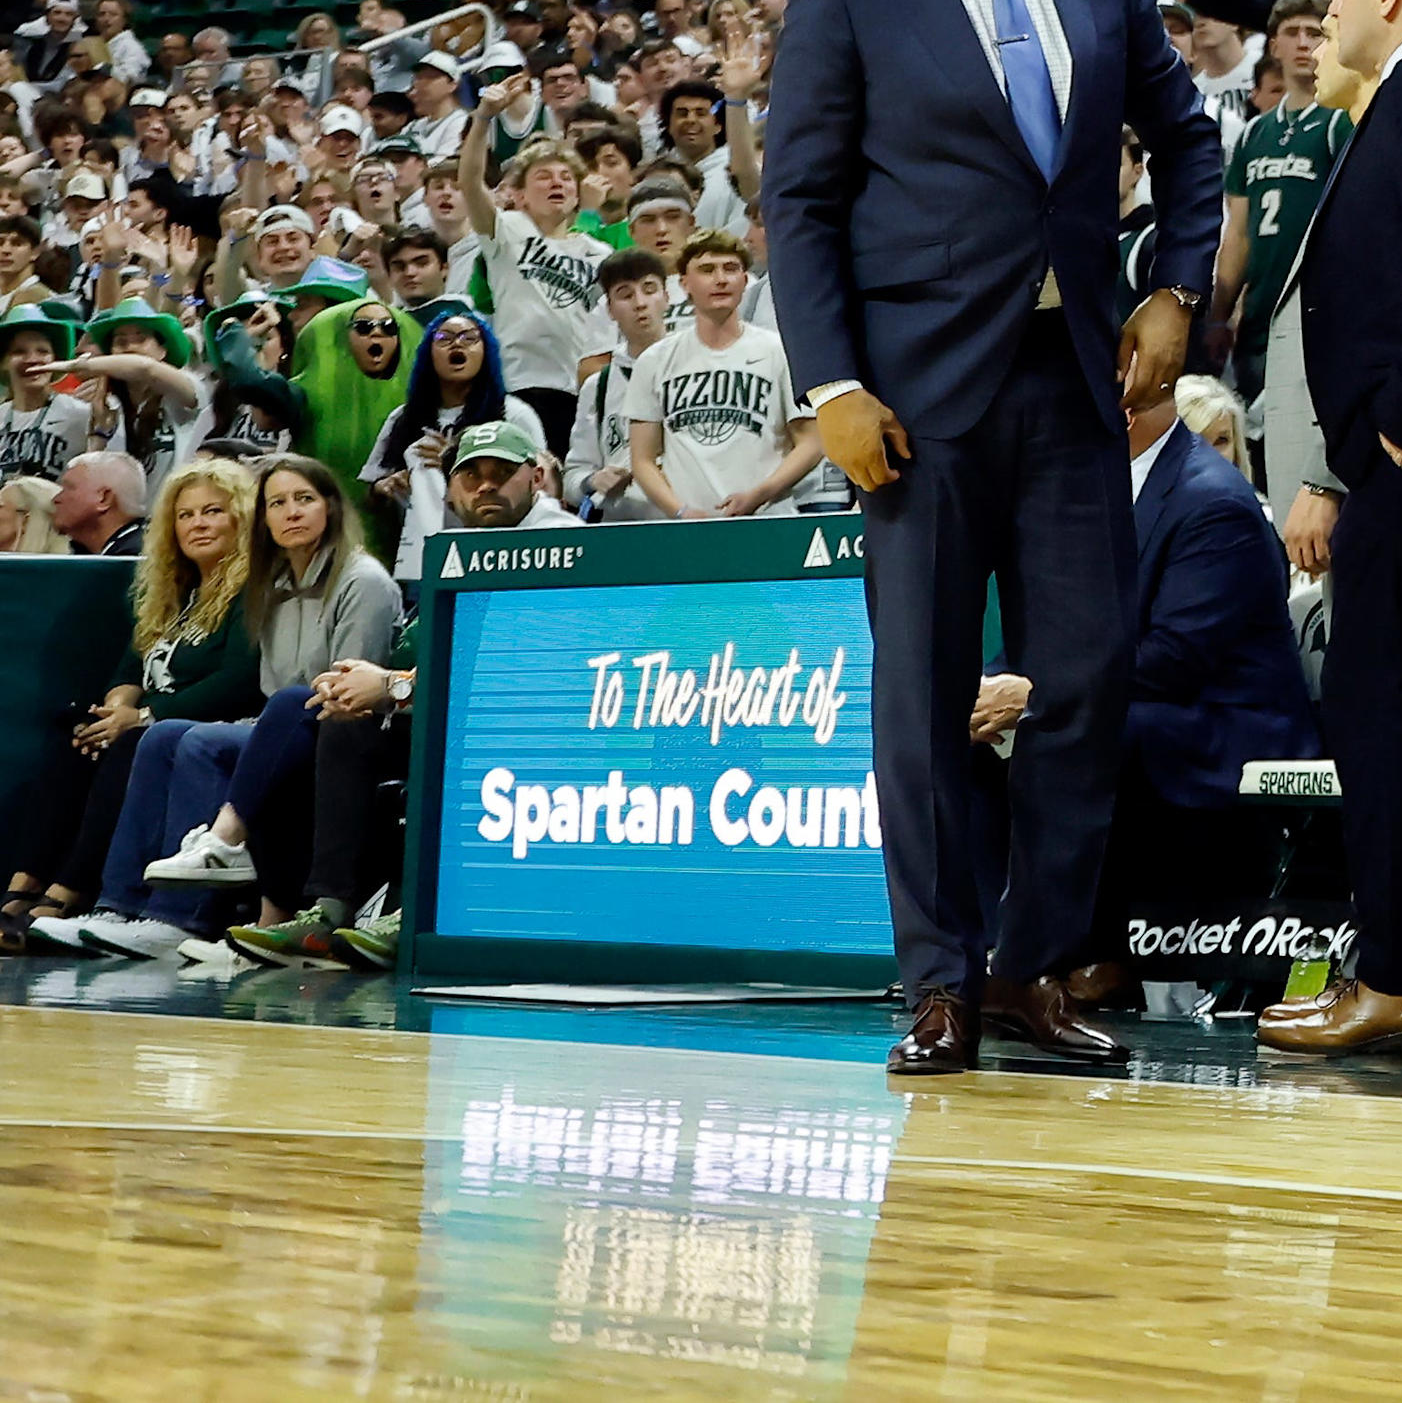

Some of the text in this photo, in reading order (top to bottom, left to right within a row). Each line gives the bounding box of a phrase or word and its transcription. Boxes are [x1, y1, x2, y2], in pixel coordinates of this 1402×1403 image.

[1258, 188, 1283, 237] 2
[661, 369, 773, 419] IZZONE
[473, 421, 501, 447] S
[587, 641, 848, 747] To The Heart of
[1259, 771, 1334, 795] SPARTANS
[477, 767, 694, 859] Spartan
